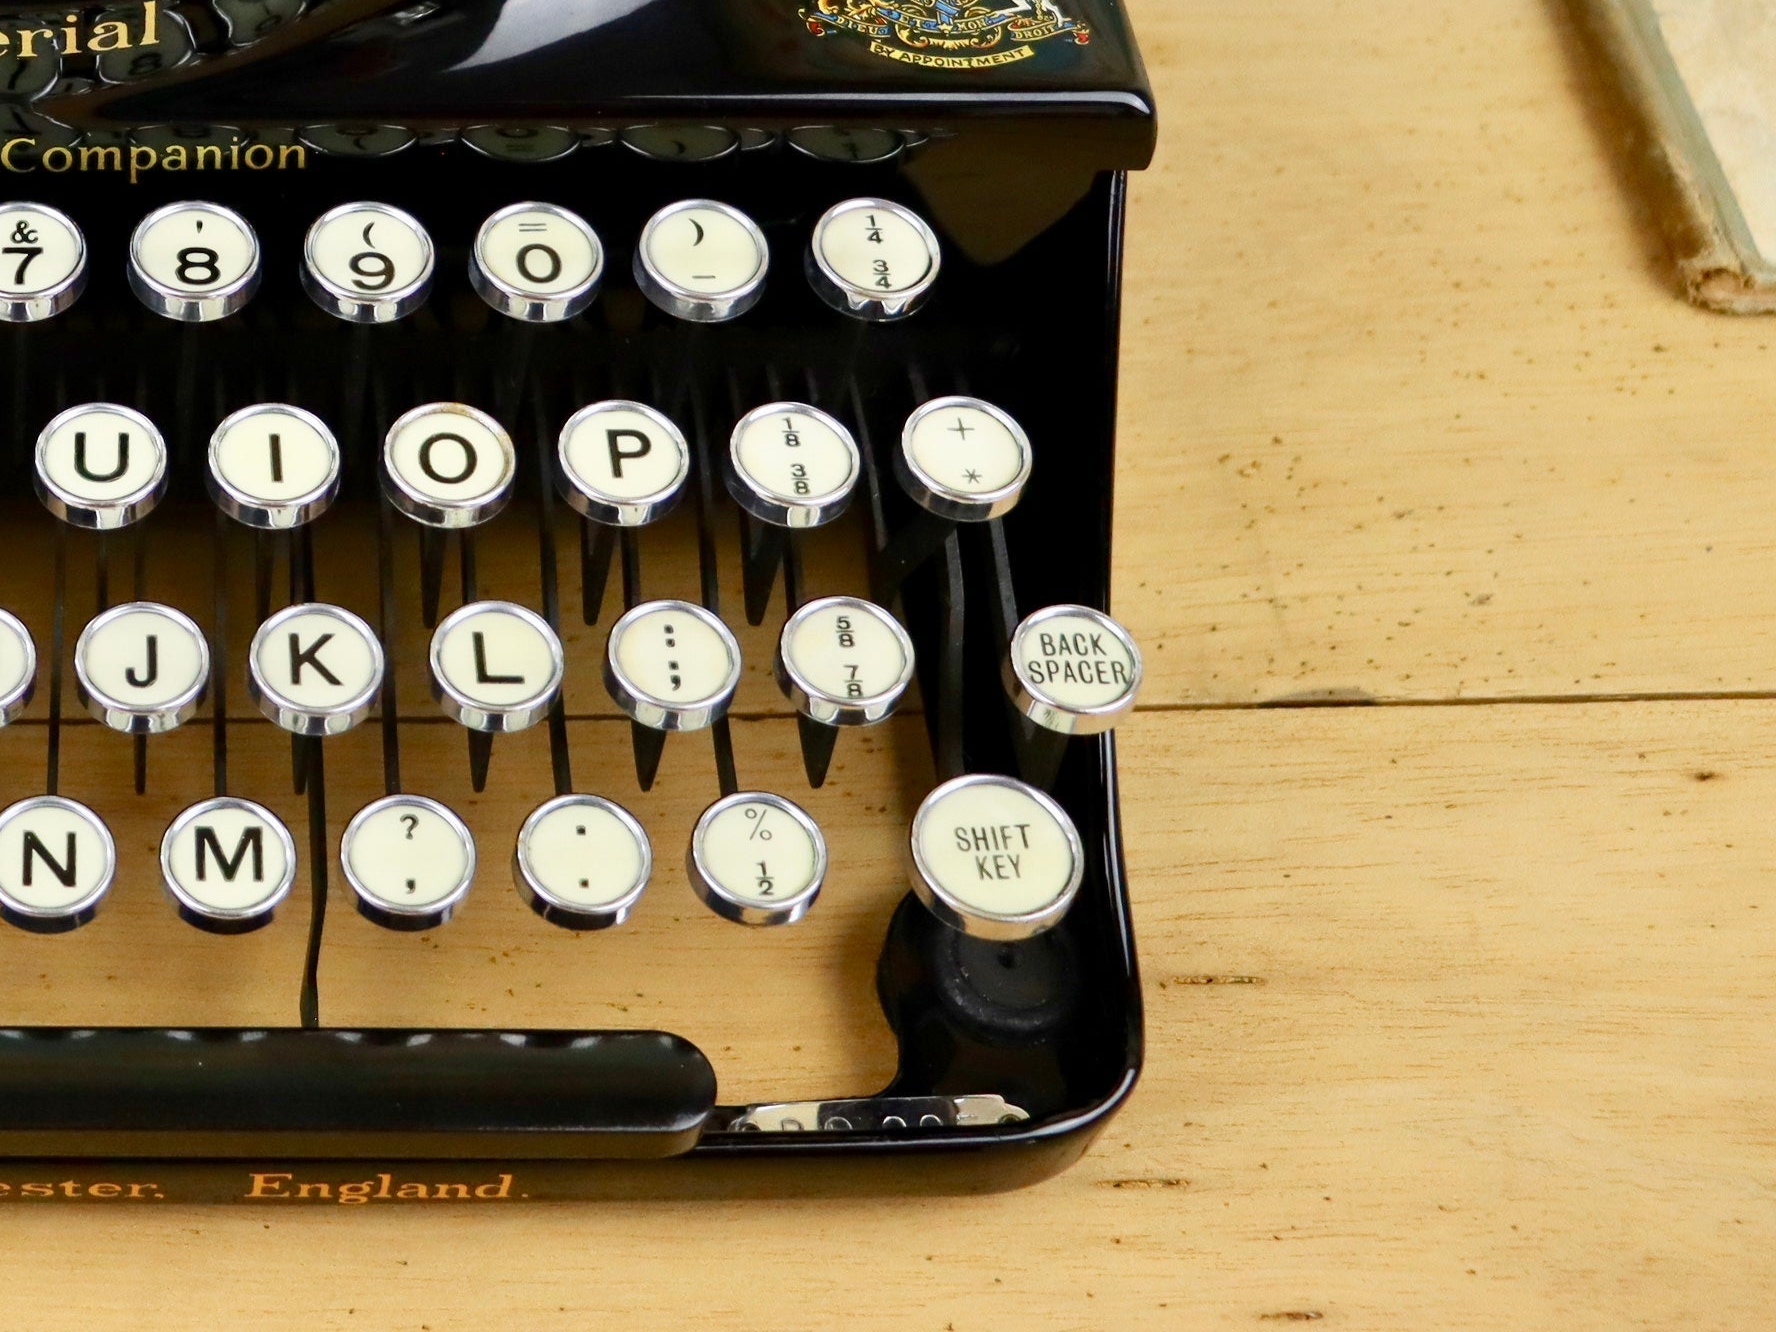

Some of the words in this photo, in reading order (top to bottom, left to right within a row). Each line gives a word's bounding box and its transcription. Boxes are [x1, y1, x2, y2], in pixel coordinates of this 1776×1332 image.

[872, 44, 893, 59] BY
[899, 48, 1025, 68] APPOINTMENT
[0, 137, 307, 183] Companion
[1, 246, 44, 284] 7
[174, 246, 221, 285] 8
[349, 251, 396, 290] 9
[515, 242, 561, 284] 0
[72, 432, 129, 482] U
[269, 434, 282, 482] I
[418, 432, 477, 485] O
[607, 430, 651, 478] P
[126, 635, 157, 688] J
[289, 633, 342, 685] K
[473, 632, 524, 684] L
[1040, 634, 1106, 656] BACK
[1028, 658, 1130, 687] SPACER
[23, 831, 76, 887] N
[195, 827, 263, 881] M
[956, 825, 1029, 856] SHIFT
[976, 855, 1023, 882] KEY
[244, 1173, 530, 1205] England.
